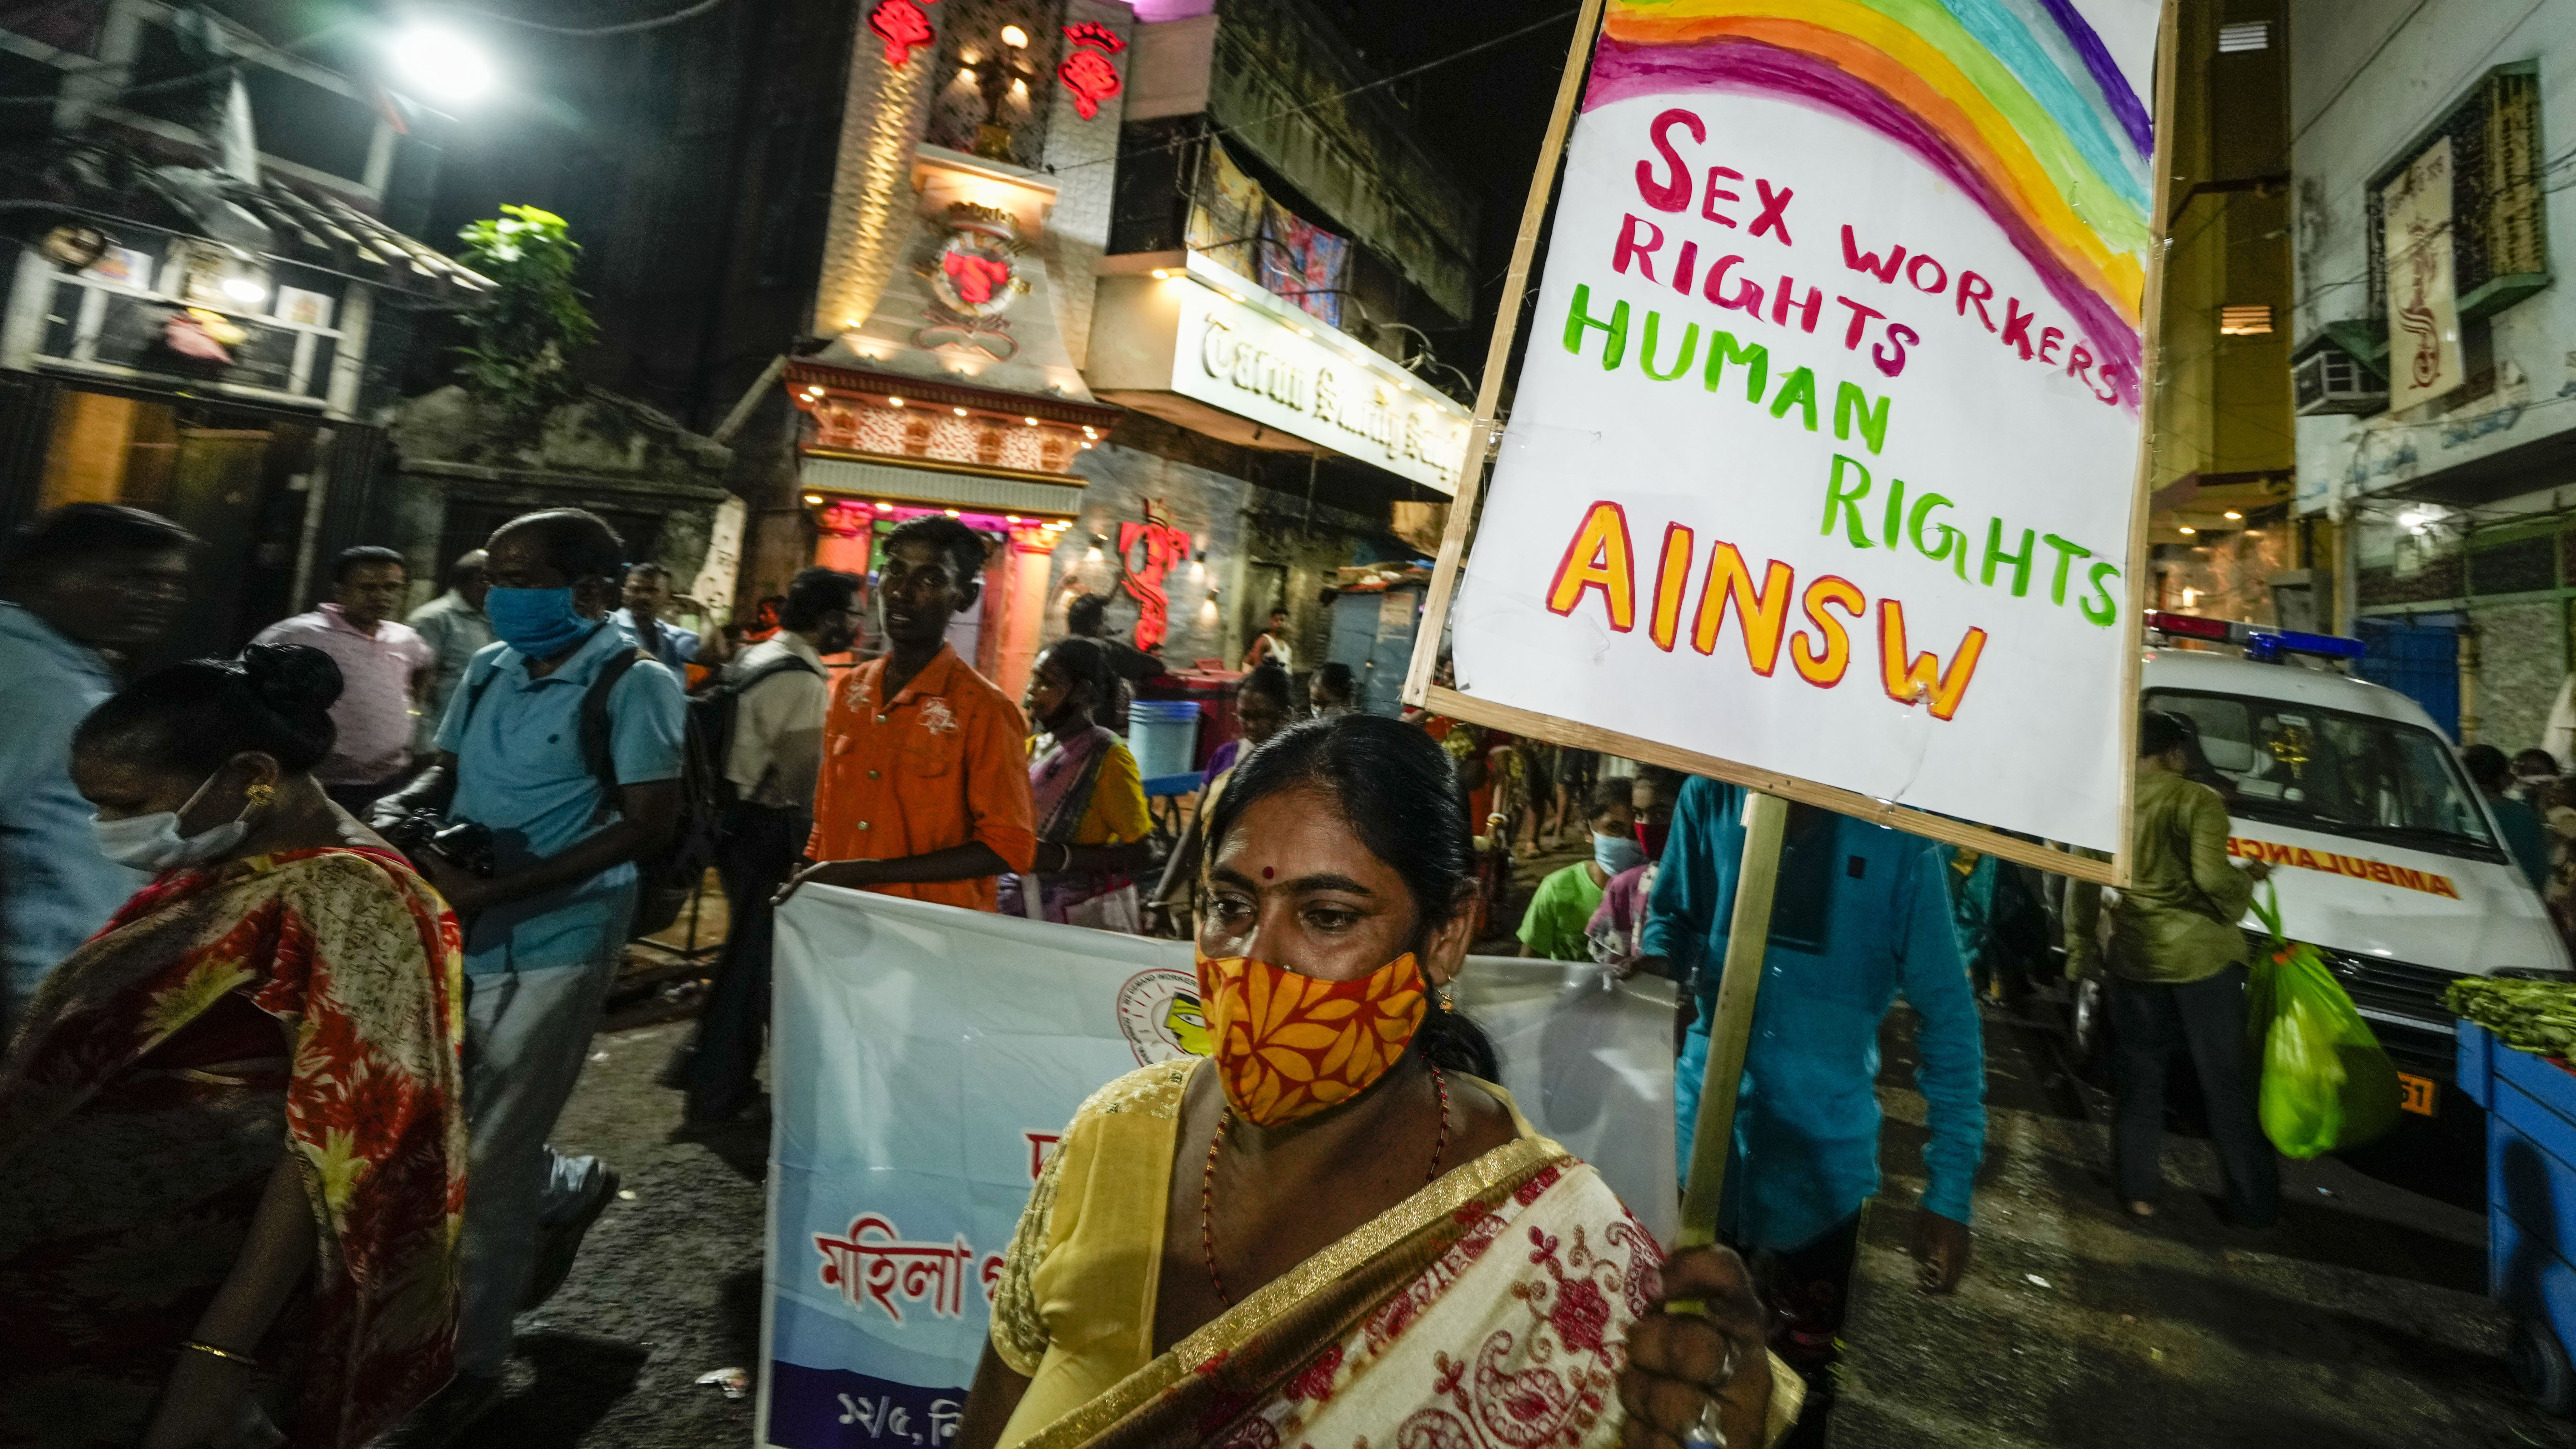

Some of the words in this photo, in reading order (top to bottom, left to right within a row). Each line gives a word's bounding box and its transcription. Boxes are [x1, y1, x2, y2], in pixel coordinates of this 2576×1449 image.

[1612, 213, 1920, 377] RIGHTS
[1635, 108, 1794, 247] SEX
[1841, 224, 2120, 406] WORKERS
[1563, 283, 1891, 456] HUMAN
[1546, 500, 1987, 722] AINSW
[1821, 453, 2121, 627] RIGHTS
[1127, 974, 1156, 995] DEMAND
[815, 1217, 972, 1321] মহিলা
